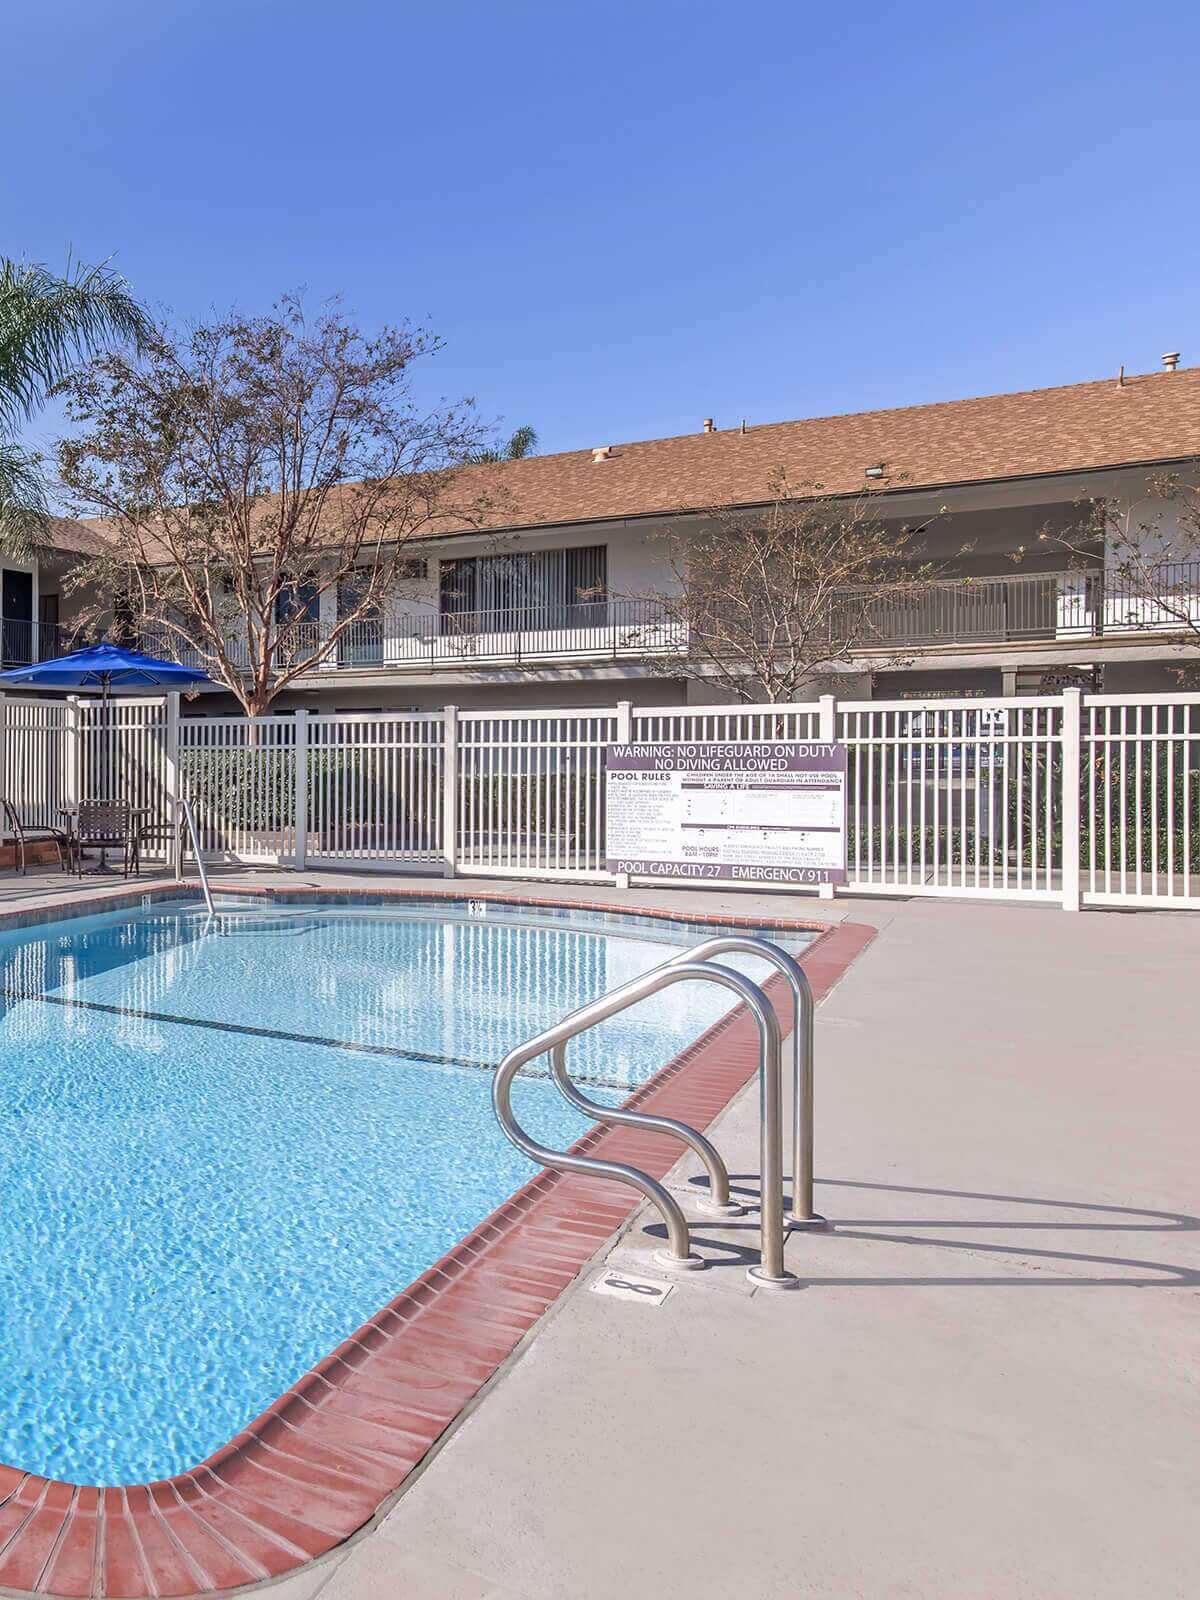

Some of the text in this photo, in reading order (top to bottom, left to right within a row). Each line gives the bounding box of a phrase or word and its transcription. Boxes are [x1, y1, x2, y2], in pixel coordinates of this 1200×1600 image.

[613, 745, 837, 757] WARNING: NO LIFEGUARD ON DUTY
[655, 759, 788, 771] NO DIVING ALLOWED
[611, 773, 671, 781] POOL RULES
[700, 845, 719, 853] HOURS
[617, 861, 829, 882] POOL CAPACITY 27 EMERGENCY 911
